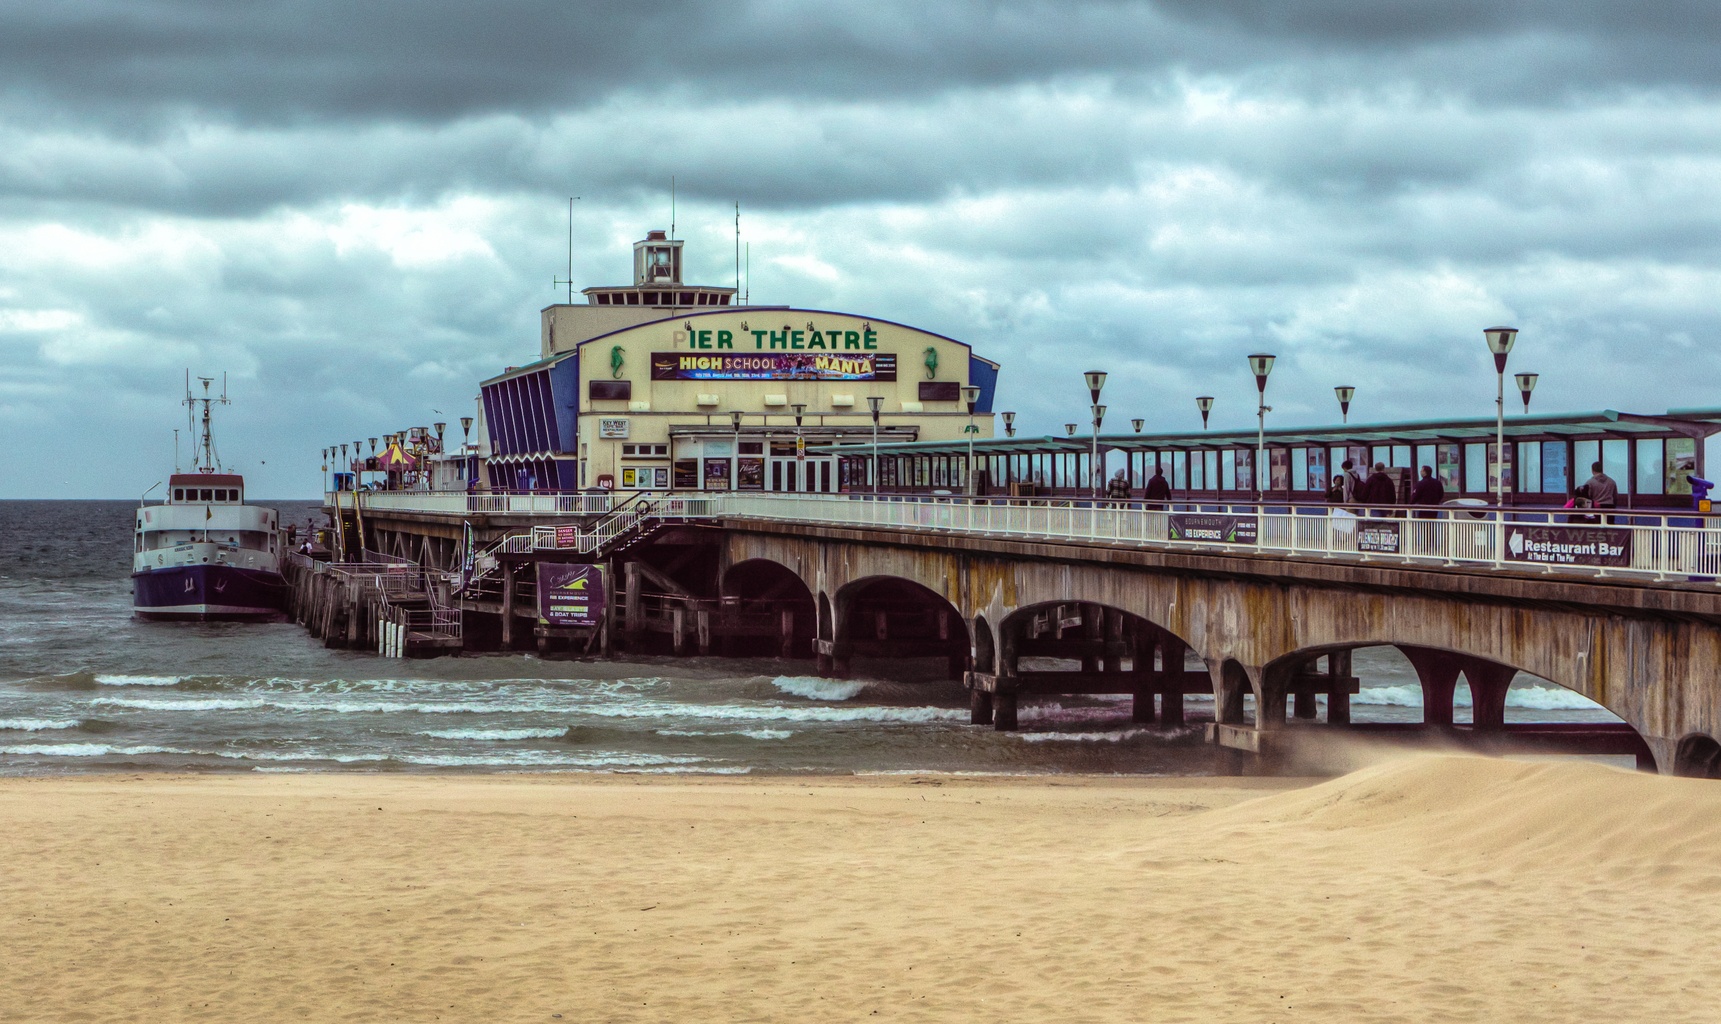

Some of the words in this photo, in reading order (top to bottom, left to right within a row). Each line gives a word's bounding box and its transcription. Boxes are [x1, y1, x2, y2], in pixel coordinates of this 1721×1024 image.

[673, 330, 733, 349] PIER
[751, 330, 878, 349] THEATRE
[680, 356, 723, 370] HIGH
[725, 357, 777, 370] SCHOOL
[815, 355, 873, 375] MANIA
[1185, 518, 1222, 526] BOURNEMOUTH
[1193, 529, 1222, 539] EXPERIENCE
[1528, 528, 1560, 540] KEY
[1565, 529, 1619, 542] WEST
[1524, 539, 1596, 555] Restaurant
[1599, 542, 1625, 556] Bar
